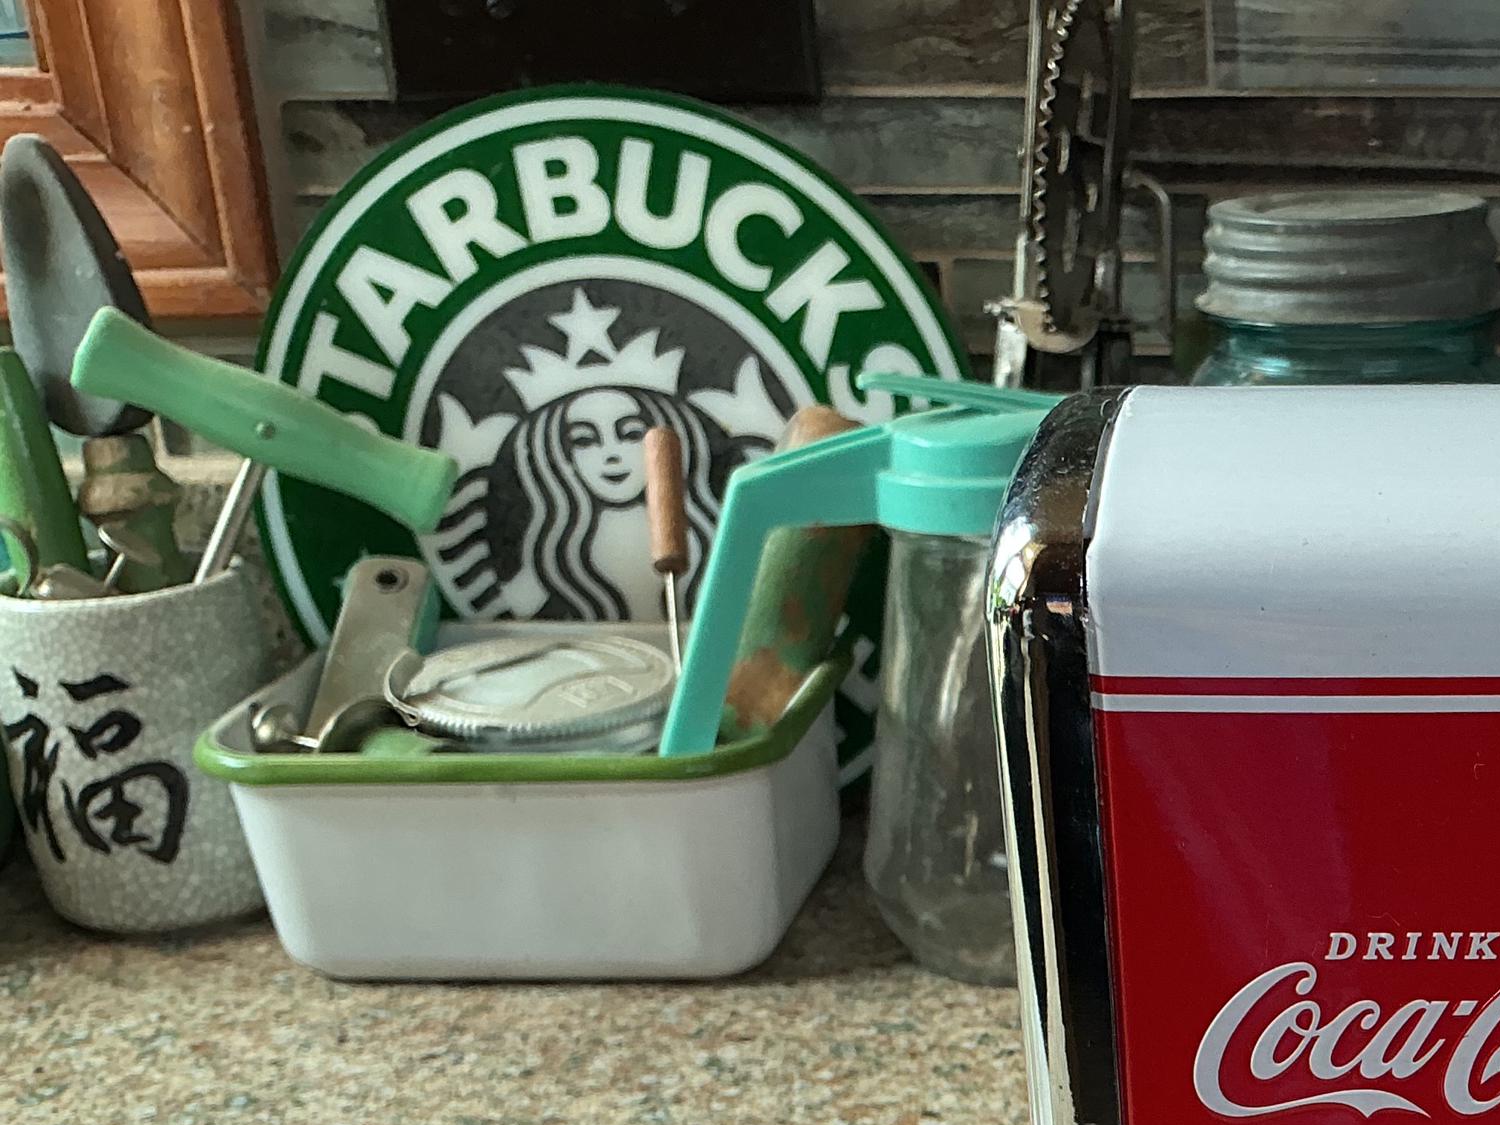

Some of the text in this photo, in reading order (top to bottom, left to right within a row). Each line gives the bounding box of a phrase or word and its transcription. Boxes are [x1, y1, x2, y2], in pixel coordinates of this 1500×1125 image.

[297, 136, 930, 436] TARBUCKS
[2, 666, 190, 864] 福
[1325, 932, 1500, 960] DRINK
